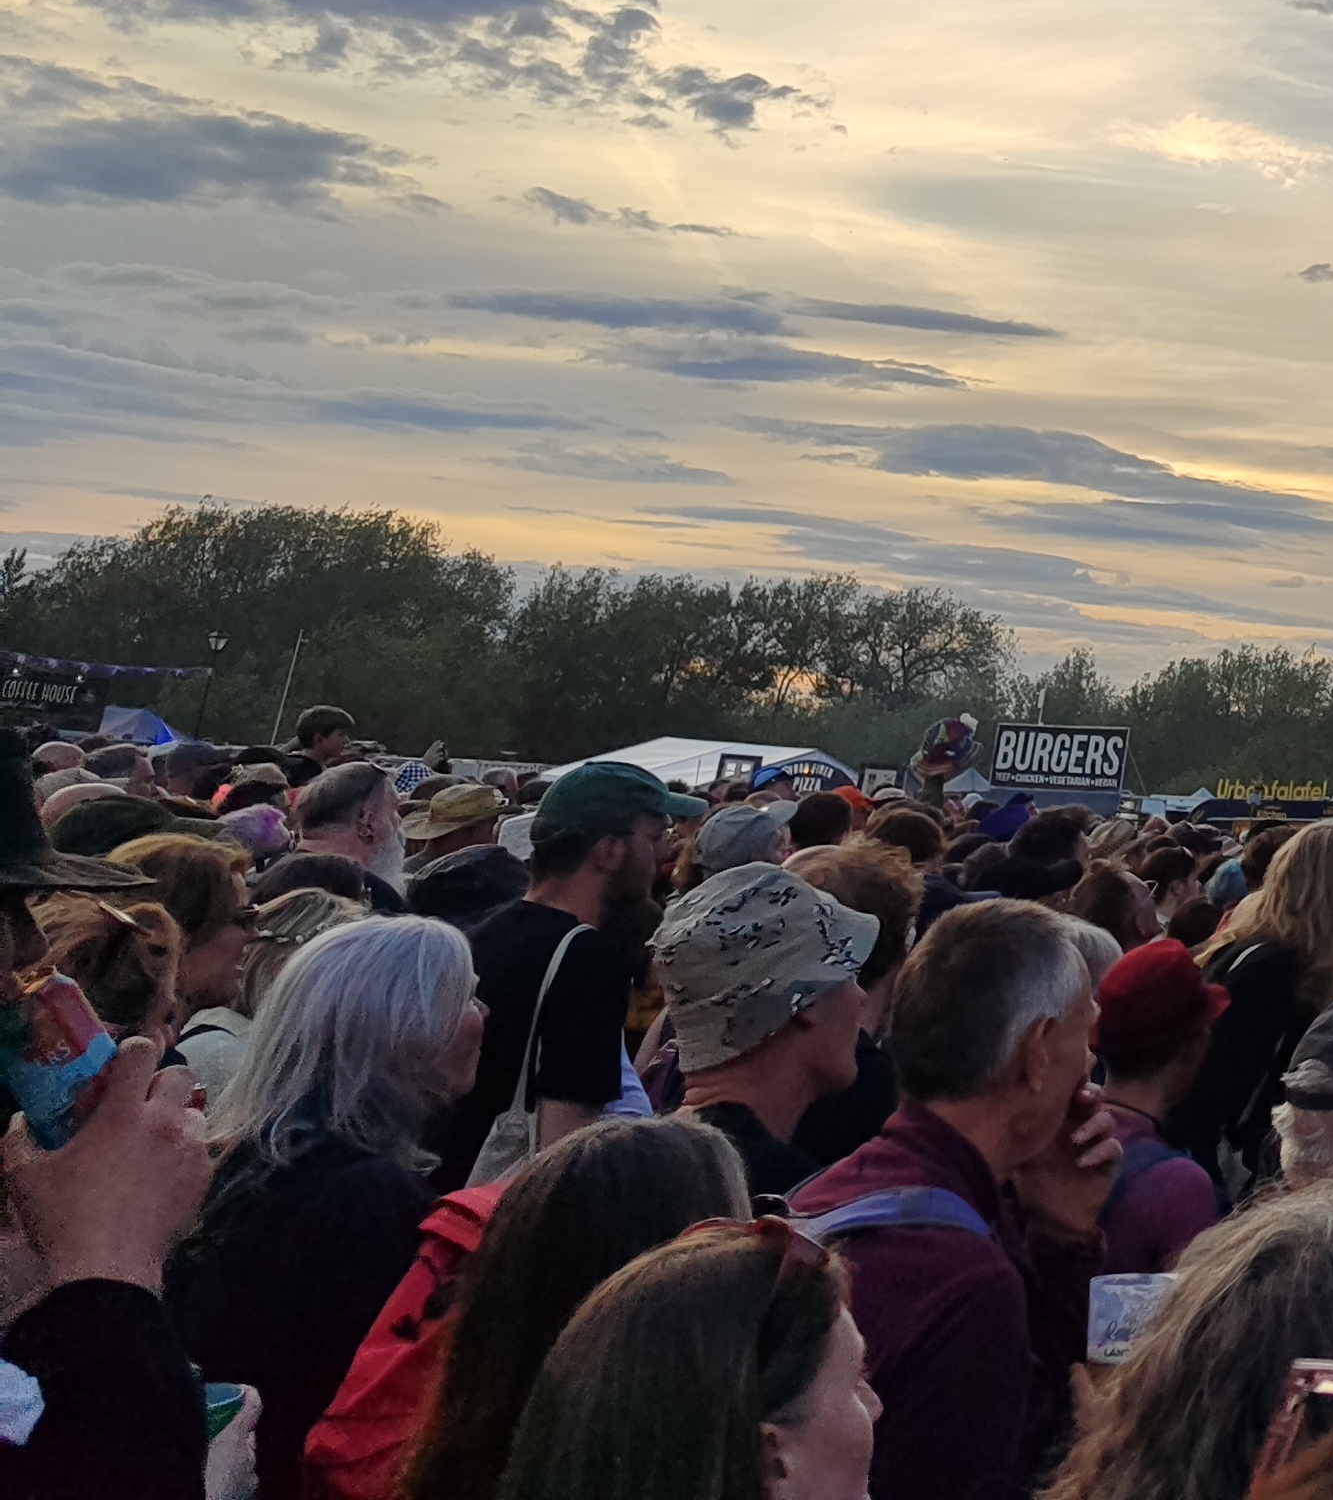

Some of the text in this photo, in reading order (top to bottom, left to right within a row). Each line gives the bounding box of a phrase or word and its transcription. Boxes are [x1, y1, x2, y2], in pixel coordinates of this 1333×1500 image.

[2, 680, 78, 703] COFFEE HOUSE
[995, 730, 1124, 776] BURGERS
[793, 776, 822, 792] PIZZA
[1015, 774, 1045, 784] CHICKEN
[1049, 776, 1091, 787] VEGETARIAN
[1216, 778, 1329, 800] Urbn falafel
